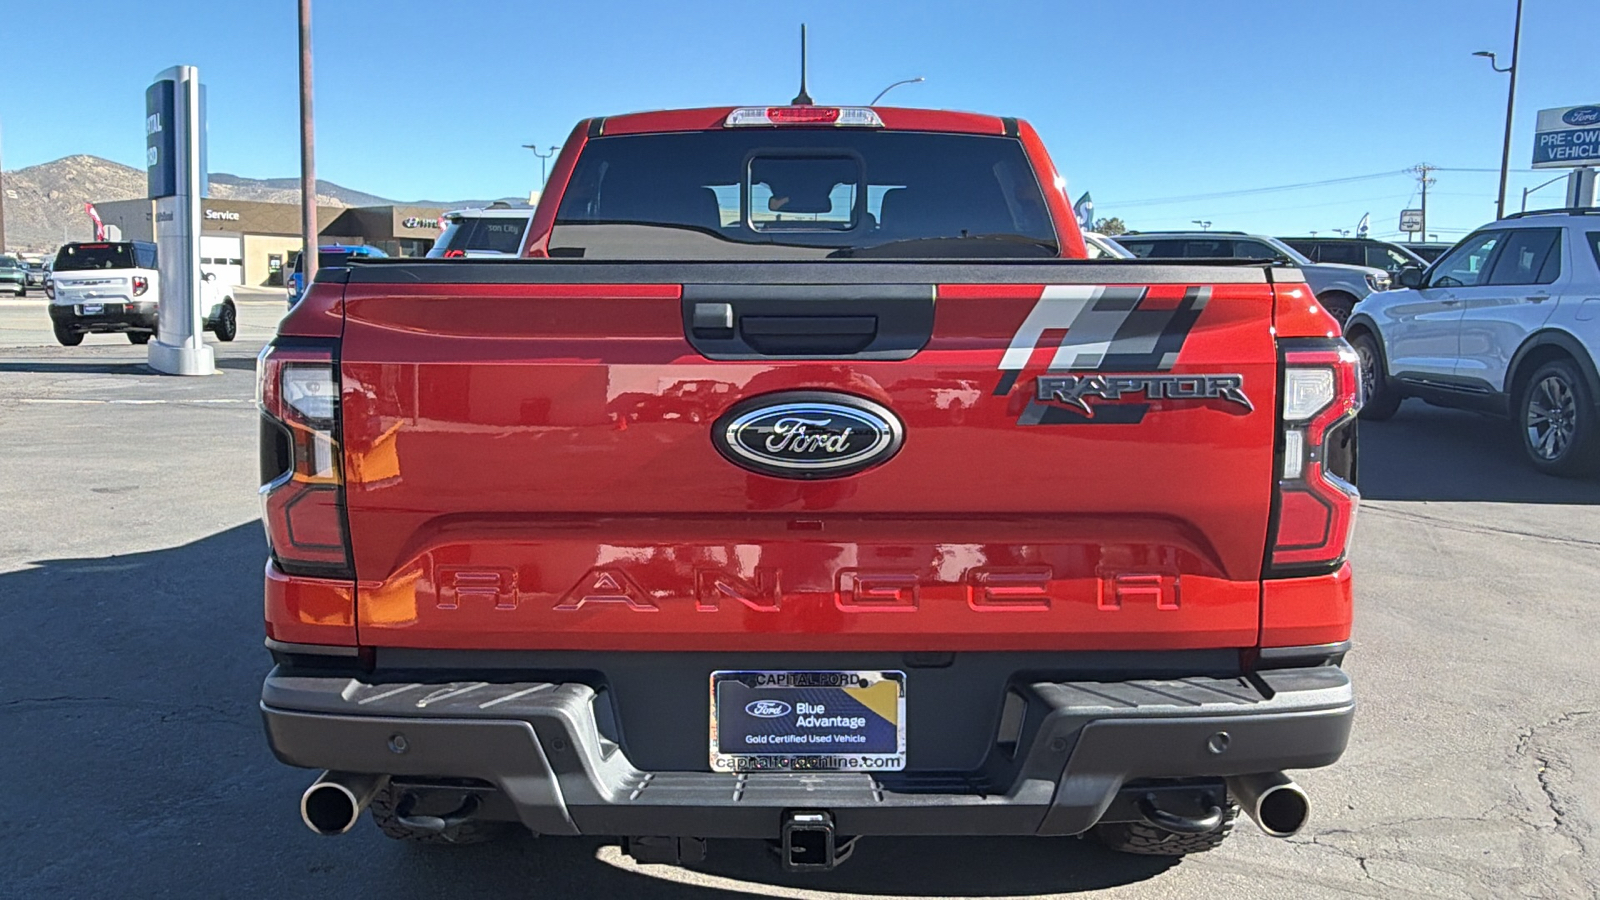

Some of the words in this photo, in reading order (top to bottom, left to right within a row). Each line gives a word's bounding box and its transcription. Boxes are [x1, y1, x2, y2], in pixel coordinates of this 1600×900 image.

[1571, 109, 1598, 122] Ford
[205, 209, 240, 220] Service
[503, 224, 519, 235] City
[1037, 373, 1254, 418] RAPTOR
[765, 417, 852, 453] Ford
[437, 565, 1181, 613] RANGER
[756, 673, 815, 686] CAPITAL
[753, 701, 783, 715] Ford
[796, 702, 825, 714] Blue
[796, 715, 866, 729] Advantage
[745, 734, 767, 744] Gold
[768, 734, 807, 744] Certified
[809, 734, 832, 744] Used
[833, 734, 866, 744] Vehicle
[715, 755, 900, 769] capitalfordonline.com
